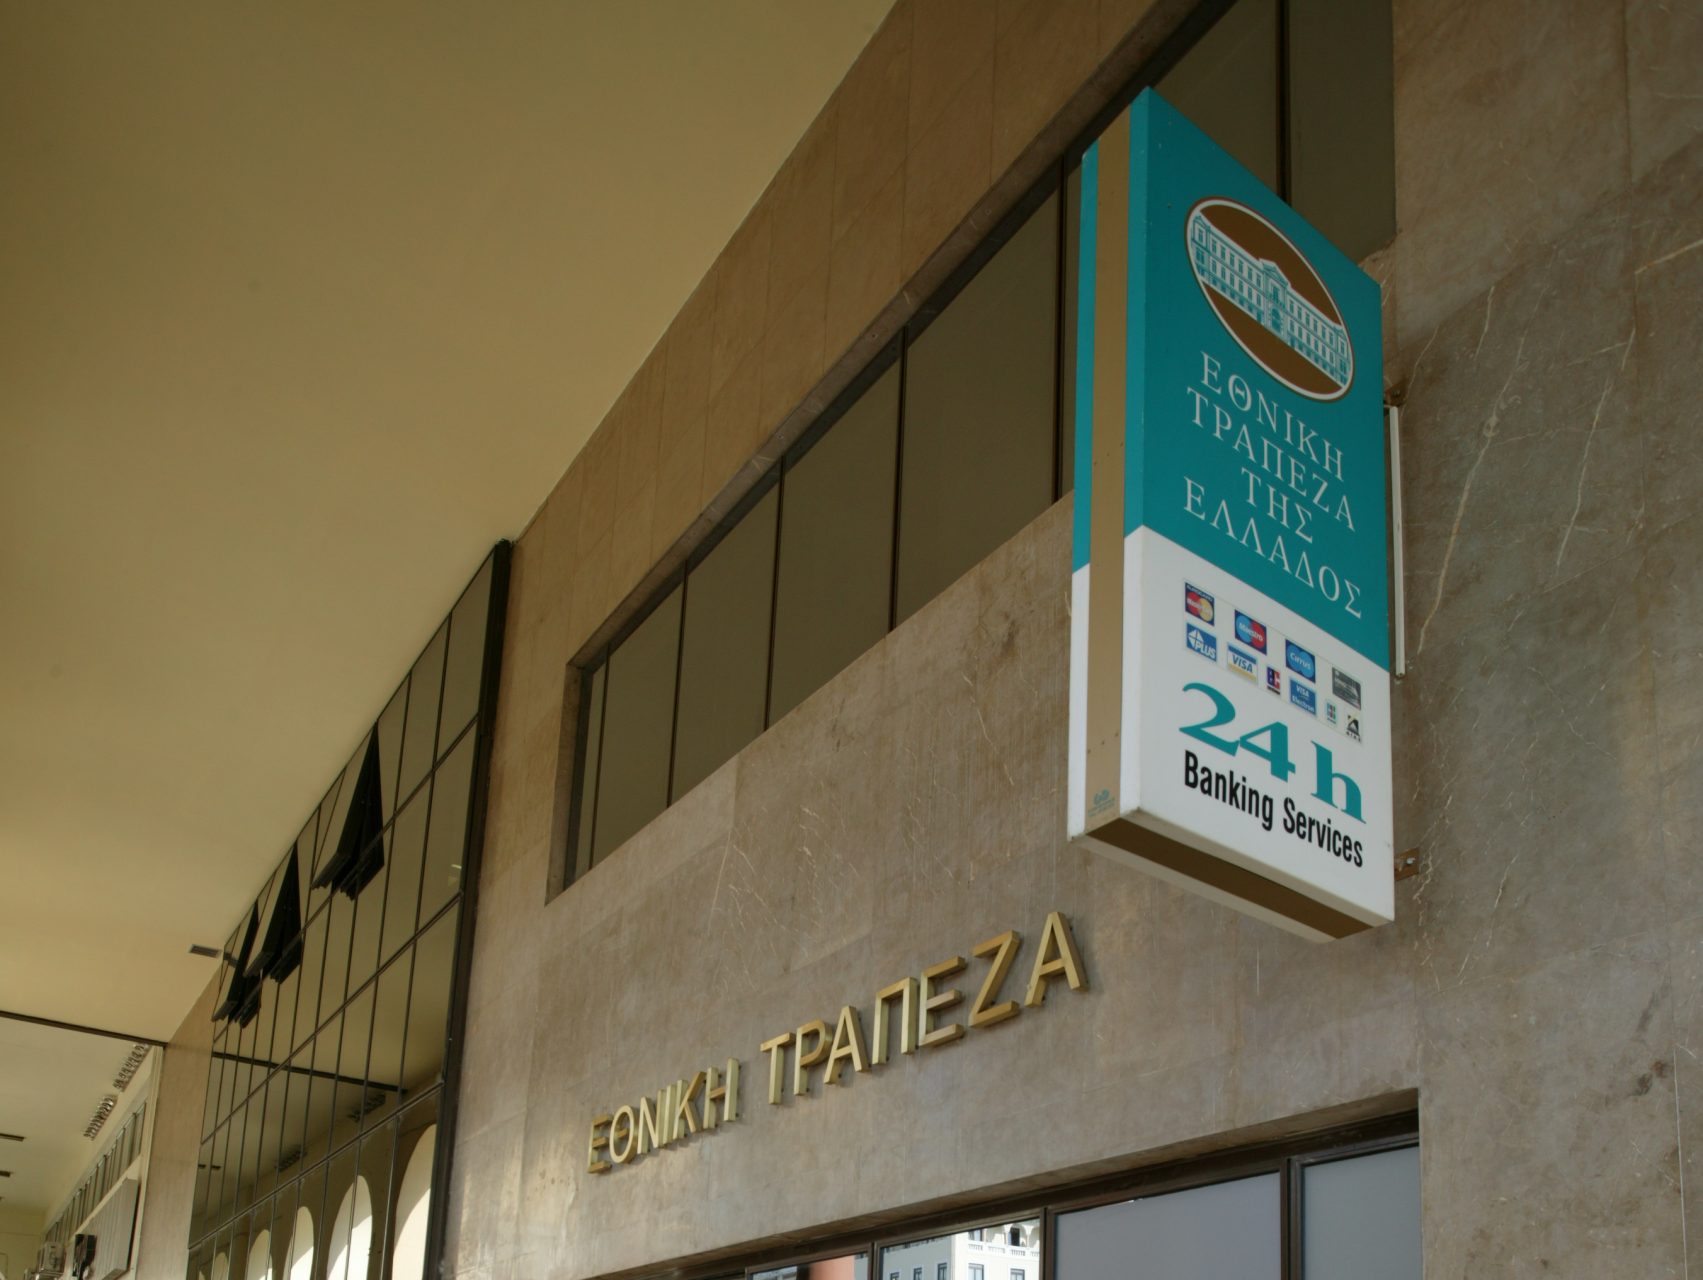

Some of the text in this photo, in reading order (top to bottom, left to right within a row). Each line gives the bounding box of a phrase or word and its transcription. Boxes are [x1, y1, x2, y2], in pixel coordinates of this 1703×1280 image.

[1200, 350, 1345, 483] ΕΘΝΙΚΗ
[1186, 385, 1356, 533] ΤΡΑΠΕΖΑ
[1241, 466, 1314, 545] ΤΗΣ
[1183, 475, 1363, 620] ΕΛΛΑΔΟΣ
[1195, 640, 1216, 660] PLUS
[1232, 653, 1254, 674] VISA
[1238, 622, 1264, 643] Maestro
[1290, 652, 1312, 671] Cirrus
[1296, 683, 1310, 698] VISA
[1184, 749, 1363, 868] Banking Services
[587, 911, 1089, 1174] ΕΘΝΙΚΗ ΤΡΑΠΕΖΑ
